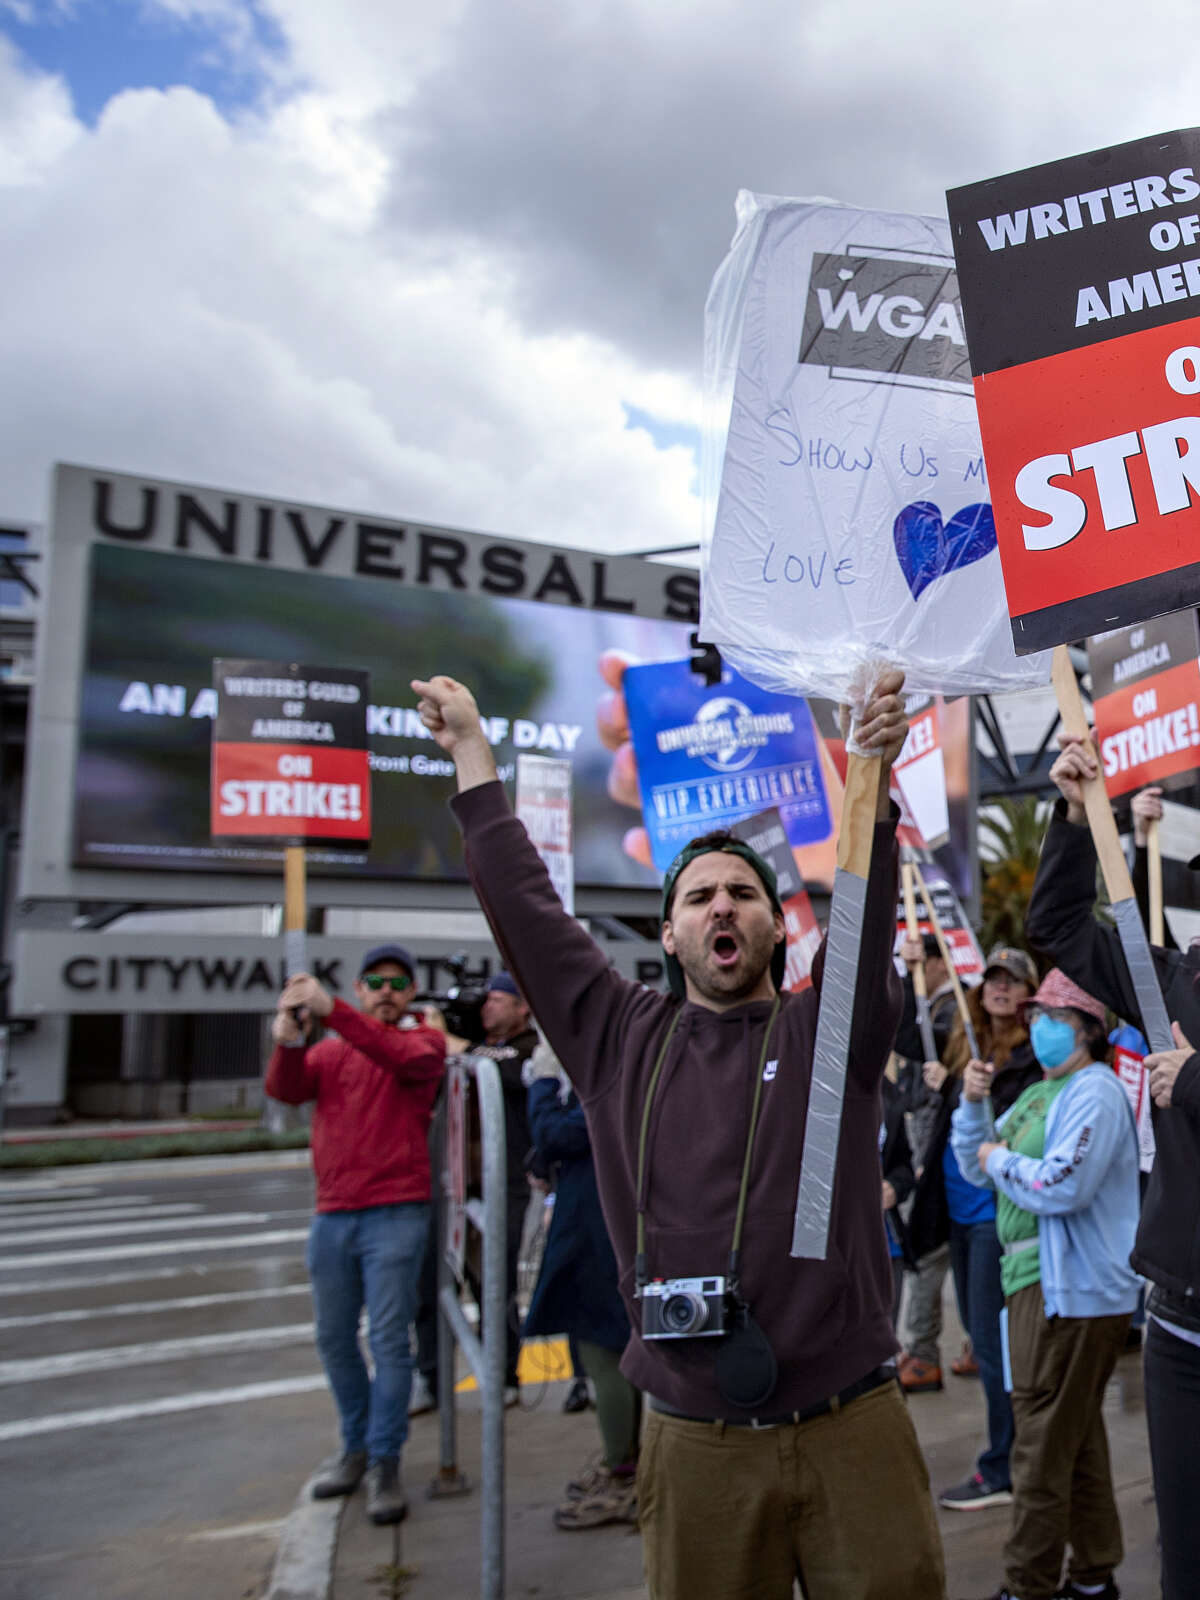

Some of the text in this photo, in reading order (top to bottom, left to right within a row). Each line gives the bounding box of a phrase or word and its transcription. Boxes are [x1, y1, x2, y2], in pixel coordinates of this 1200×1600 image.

[977, 167, 1200, 251] WRITERS
[1149, 214, 1200, 252] OF
[817, 288, 968, 346] WGA
[92, 477, 635, 612] UNIVERSAL
[762, 541, 857, 589] LOVE
[1113, 641, 1171, 683] AMERICA
[224, 677, 361, 703] WRITERS GUILD
[282, 701, 305, 717] OF
[1132, 687, 1158, 718] ON
[118, 681, 186, 717] AN
[366, 704, 436, 741] KIN
[513, 719, 583, 751] DAY
[251, 719, 335, 742] AMERICA
[277, 754, 313, 778] ON
[220, 779, 362, 822] STRIKE!
[697, 764, 817, 813] EXPERIENCE
